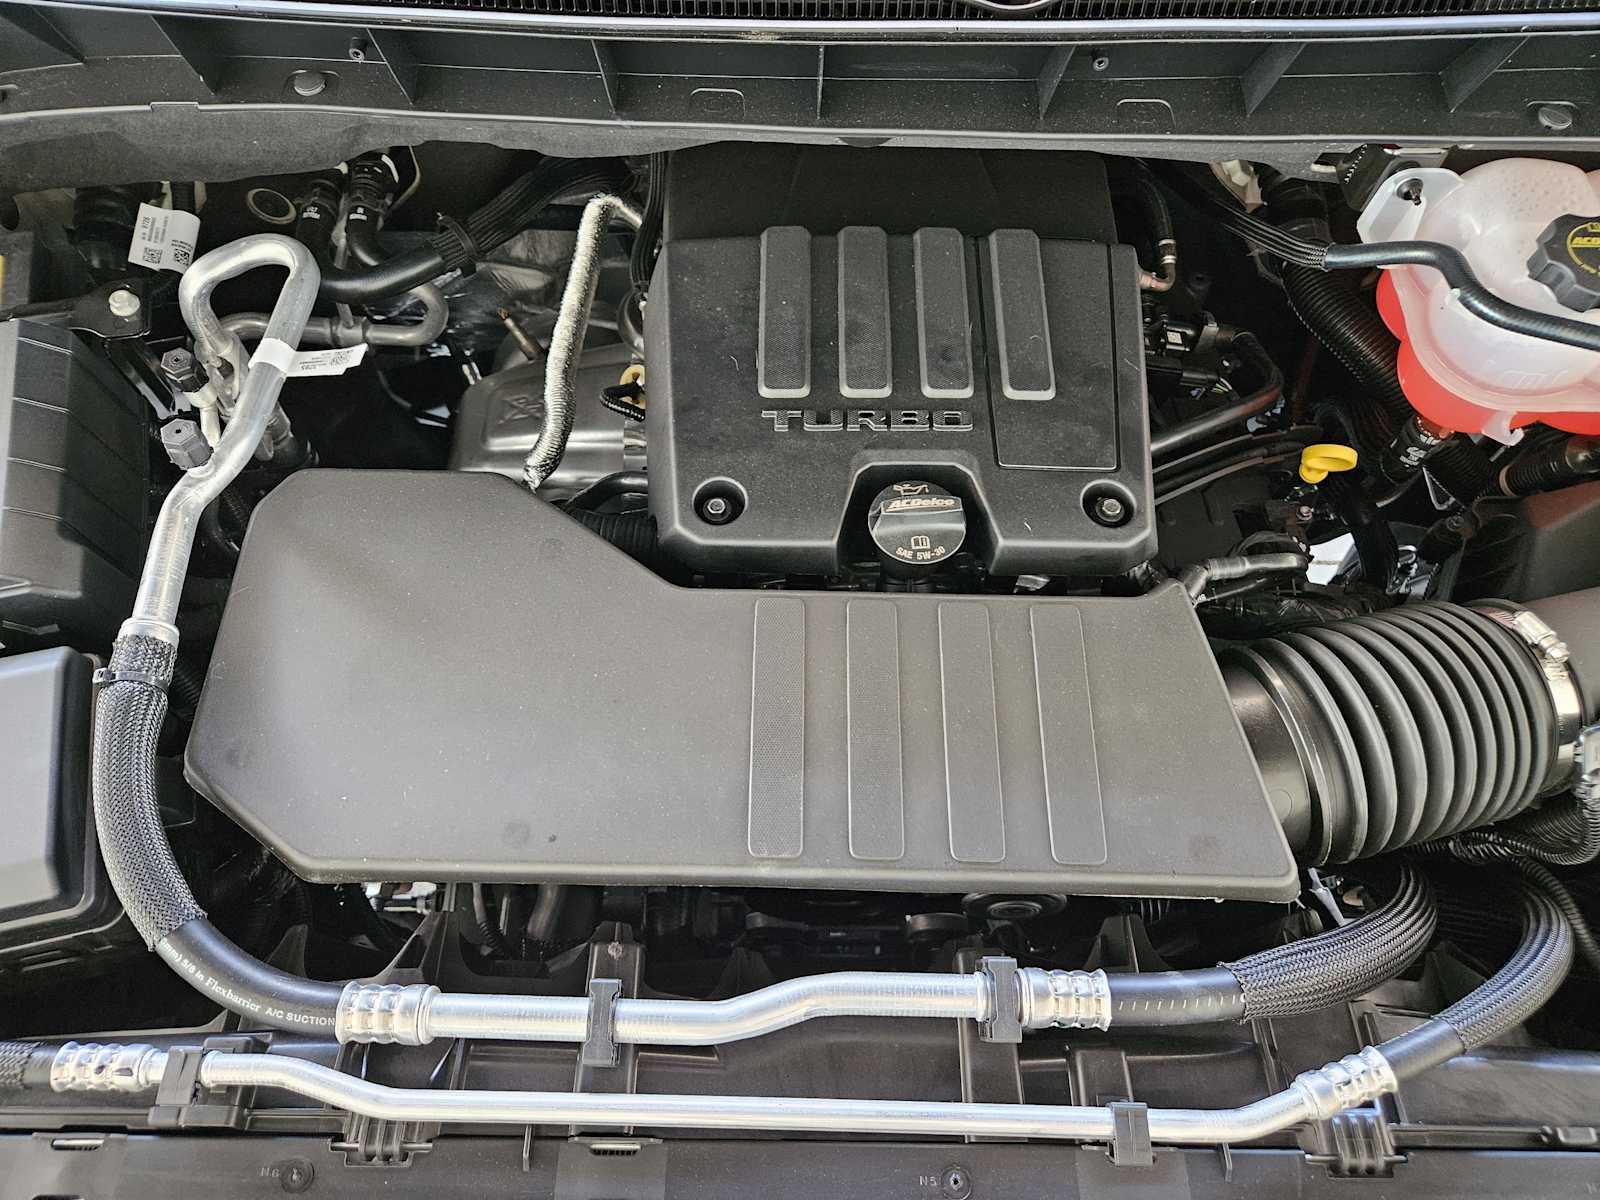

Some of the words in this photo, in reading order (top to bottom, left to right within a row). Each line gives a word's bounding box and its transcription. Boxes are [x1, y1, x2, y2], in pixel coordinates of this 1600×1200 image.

[761, 409, 973, 431] TURBO
[887, 498, 955, 510] ACDelco
[896, 547, 914, 559] SAE
[916, 545, 946, 560] 5W-30
[205, 977, 262, 1012] Flexbarrier
[265, 1007, 284, 1019] A/C
[286, 1012, 336, 1027] SUCTION
